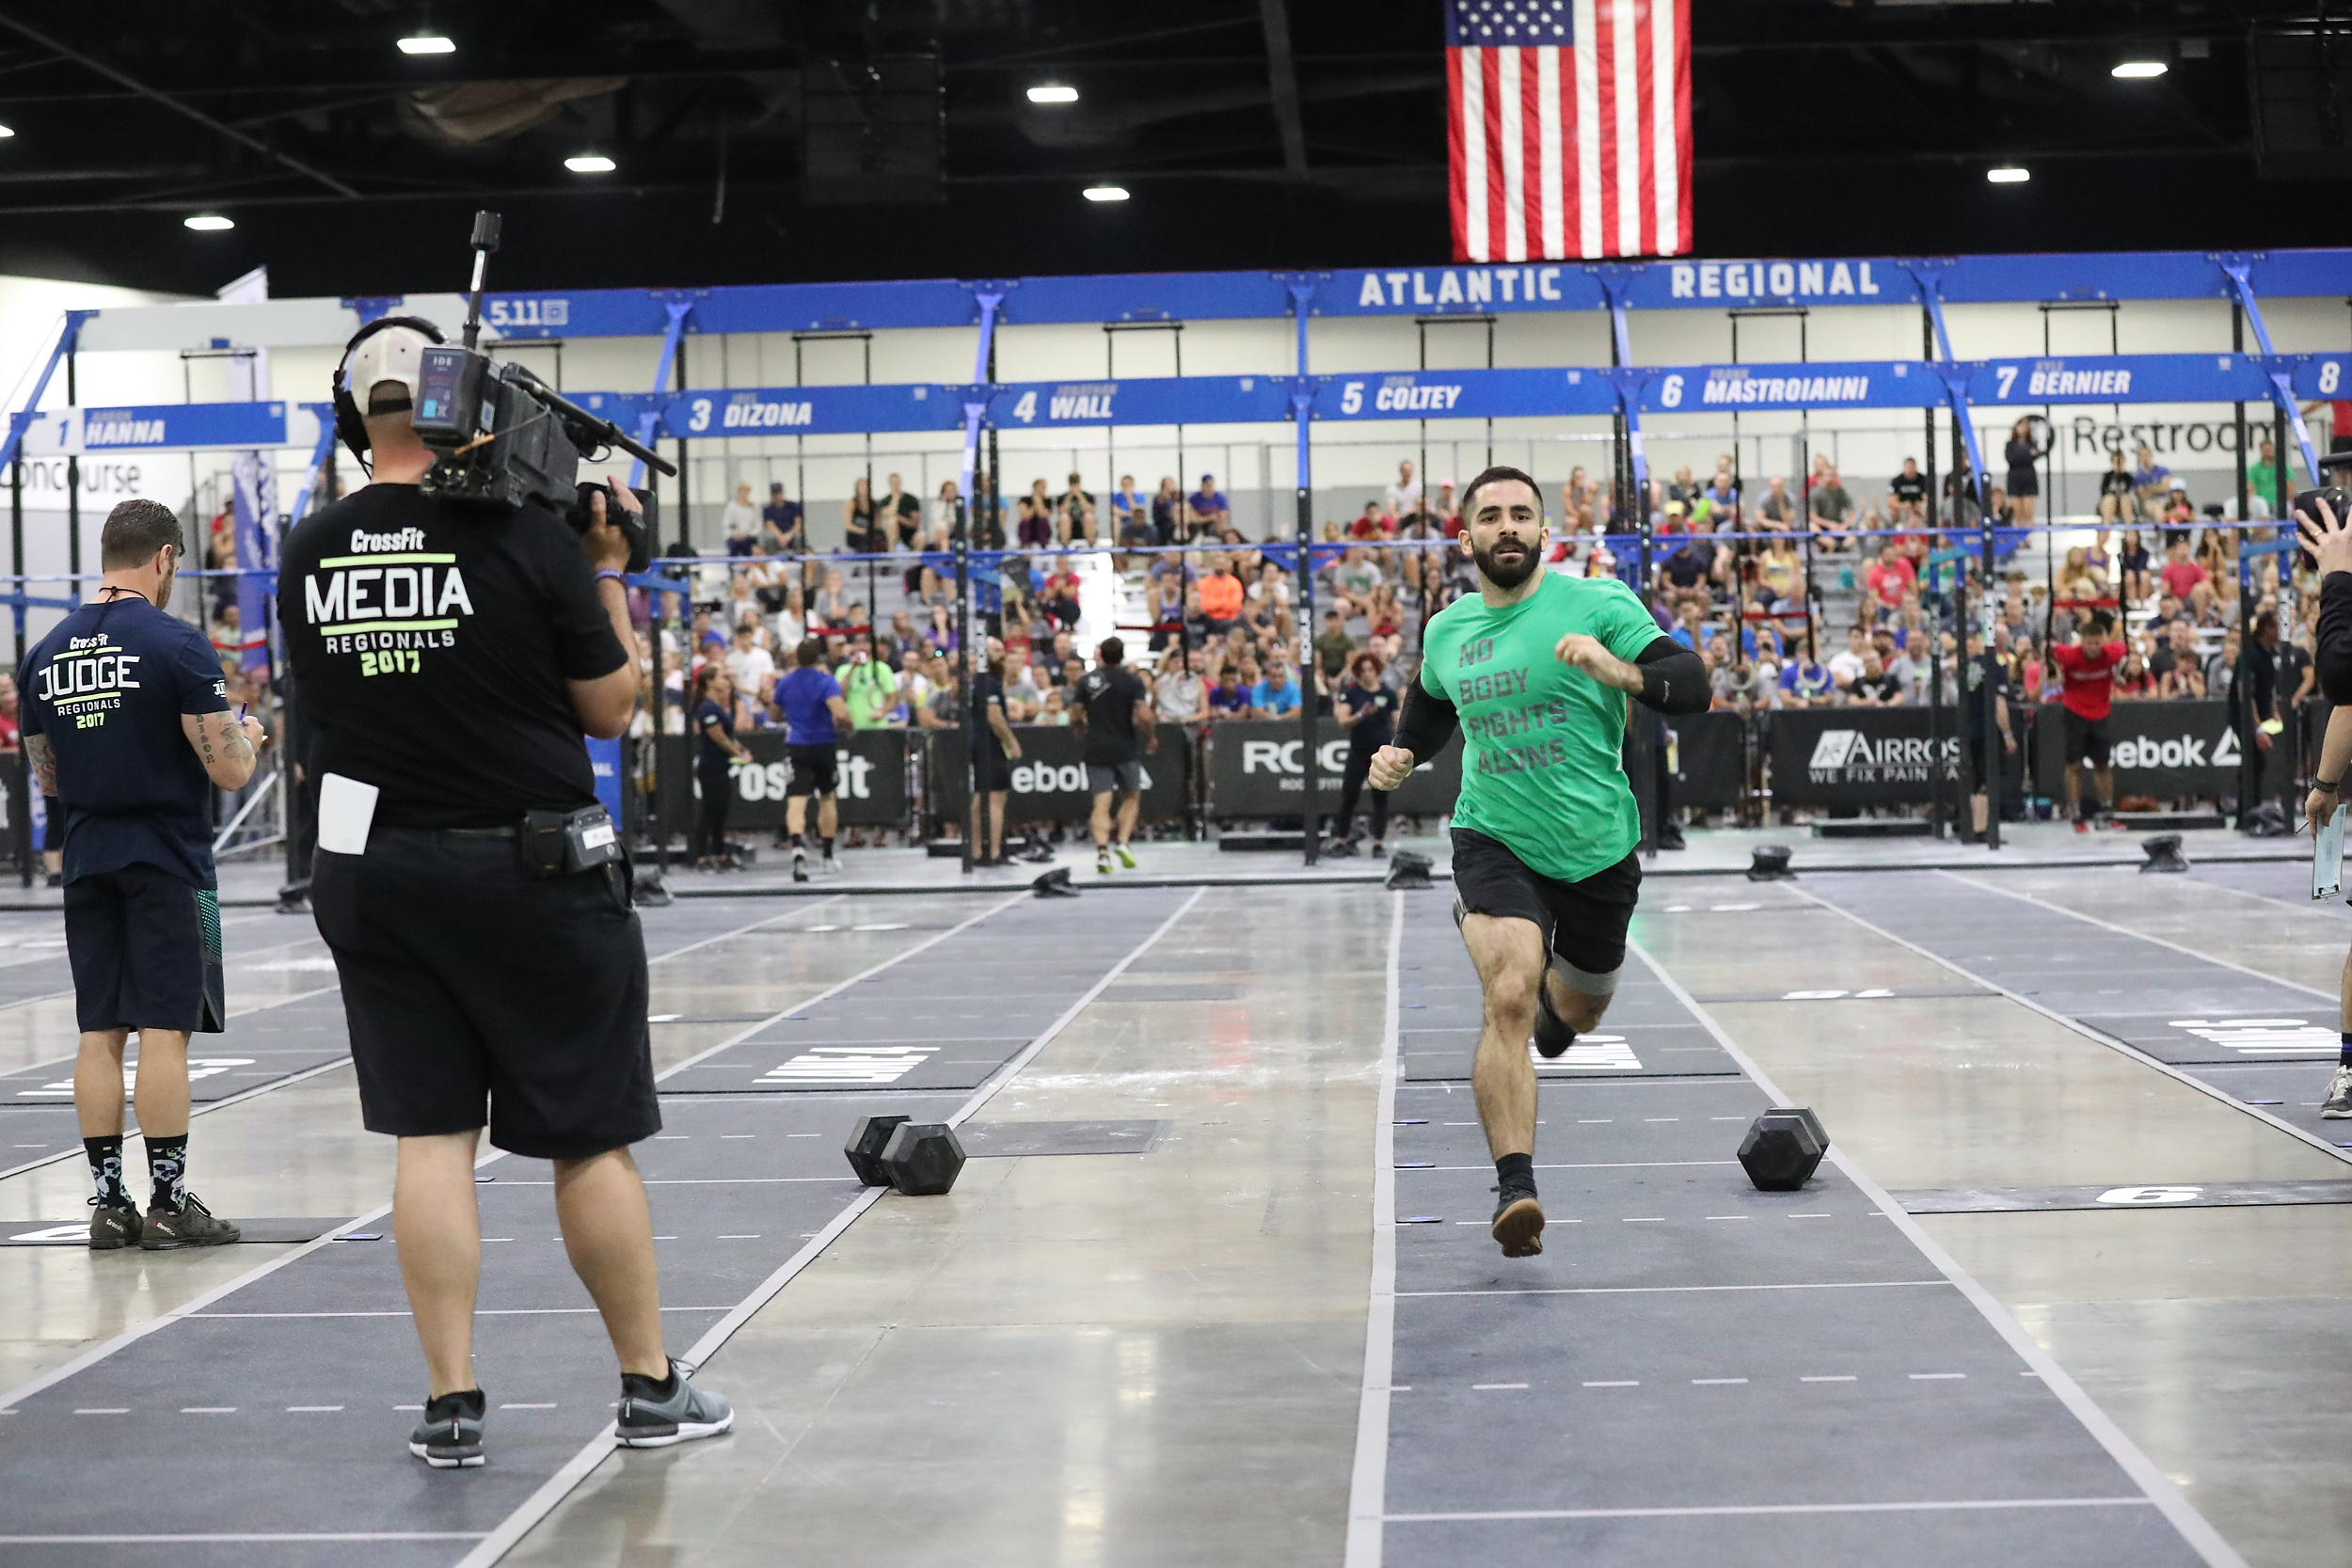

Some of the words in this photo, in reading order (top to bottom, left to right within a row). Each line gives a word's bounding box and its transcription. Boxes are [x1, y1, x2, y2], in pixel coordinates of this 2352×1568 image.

[1359, 267, 1562, 307] ATLANTIC
[1670, 261, 1881, 299] REGIONAL
[489, 299, 542, 325] 5.11
[1661, 374, 1685, 408] 6
[1702, 376, 1869, 404] MASTROIANNI
[1995, 366, 2019, 399] 7
[2027, 370, 2133, 396] BERNIER
[2317, 361, 2342, 394] 8
[1012, 390, 1038, 423] 4
[1049, 395, 1113, 420] WALL
[1341, 381, 1365, 415] 5
[1375, 385, 1462, 411] COLTEY
[688, 398, 713, 432] 3
[723, 401, 813, 428] DIZONA
[58, 419, 70, 447] 1
[85, 419, 167, 446] HANNA
[0, 460, 141, 494] oncurse
[350, 527, 425, 553] CrossFit
[305, 566, 475, 625] MEDIA
[326, 630, 455, 654] REGIONALS
[1458, 638, 1494, 669] NO
[39, 656, 141, 701] JUDGE
[360, 650, 421, 677] 2017
[1458, 667, 1529, 705] BODY
[57, 698, 120, 717] REGIONALS
[75, 712, 105, 729] 2017
[1468, 700, 1568, 740] FIGHTS
[1477, 737, 1568, 775] ALONE
[1846, 730, 1961, 765] AIRROS
[2082, 733, 2207, 769] ebok
[1808, 768, 1838, 784] WE
[1846, 768, 1876, 784] FIX
[1883, 767, 1929, 783] PAIN
